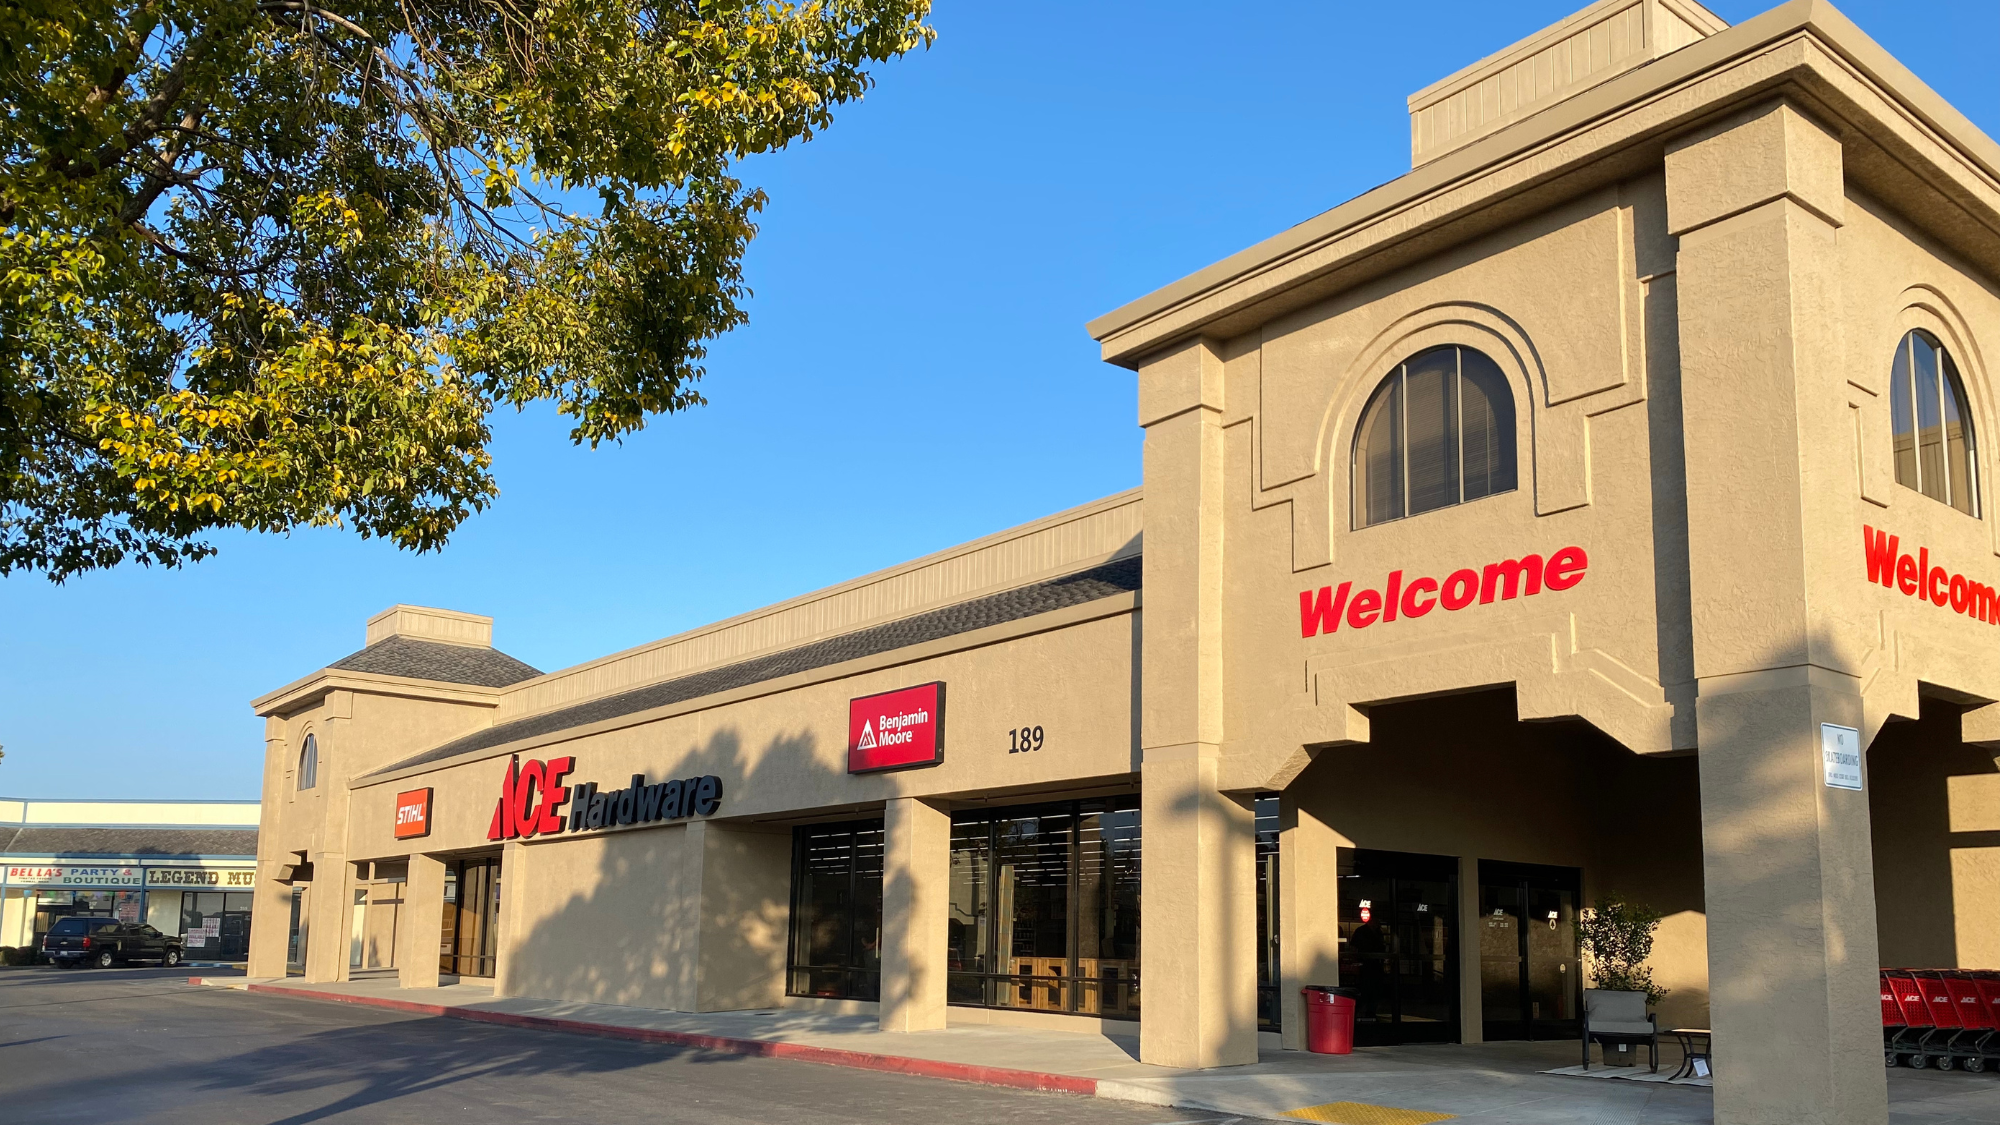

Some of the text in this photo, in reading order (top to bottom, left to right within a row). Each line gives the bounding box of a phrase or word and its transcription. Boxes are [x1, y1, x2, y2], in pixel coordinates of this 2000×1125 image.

[1863, 524, 2000, 626] Welcom
[1300, 545, 1588, 638] Welcome
[879, 707, 928, 732] Benjamin
[878, 730, 913, 747] Moore
[1008, 725, 1044, 754] 189
[487, 754, 723, 839] ACE Hardware
[397, 804, 424, 825] STIHL
[10, 868, 133, 877] BELLA'S PARTY &
[63, 877, 141, 885] BOUTIQUE
[148, 870, 256, 885] LEGEND MU
[1359, 899, 1371, 908] ACE
[1417, 903, 1428, 911] ACE
